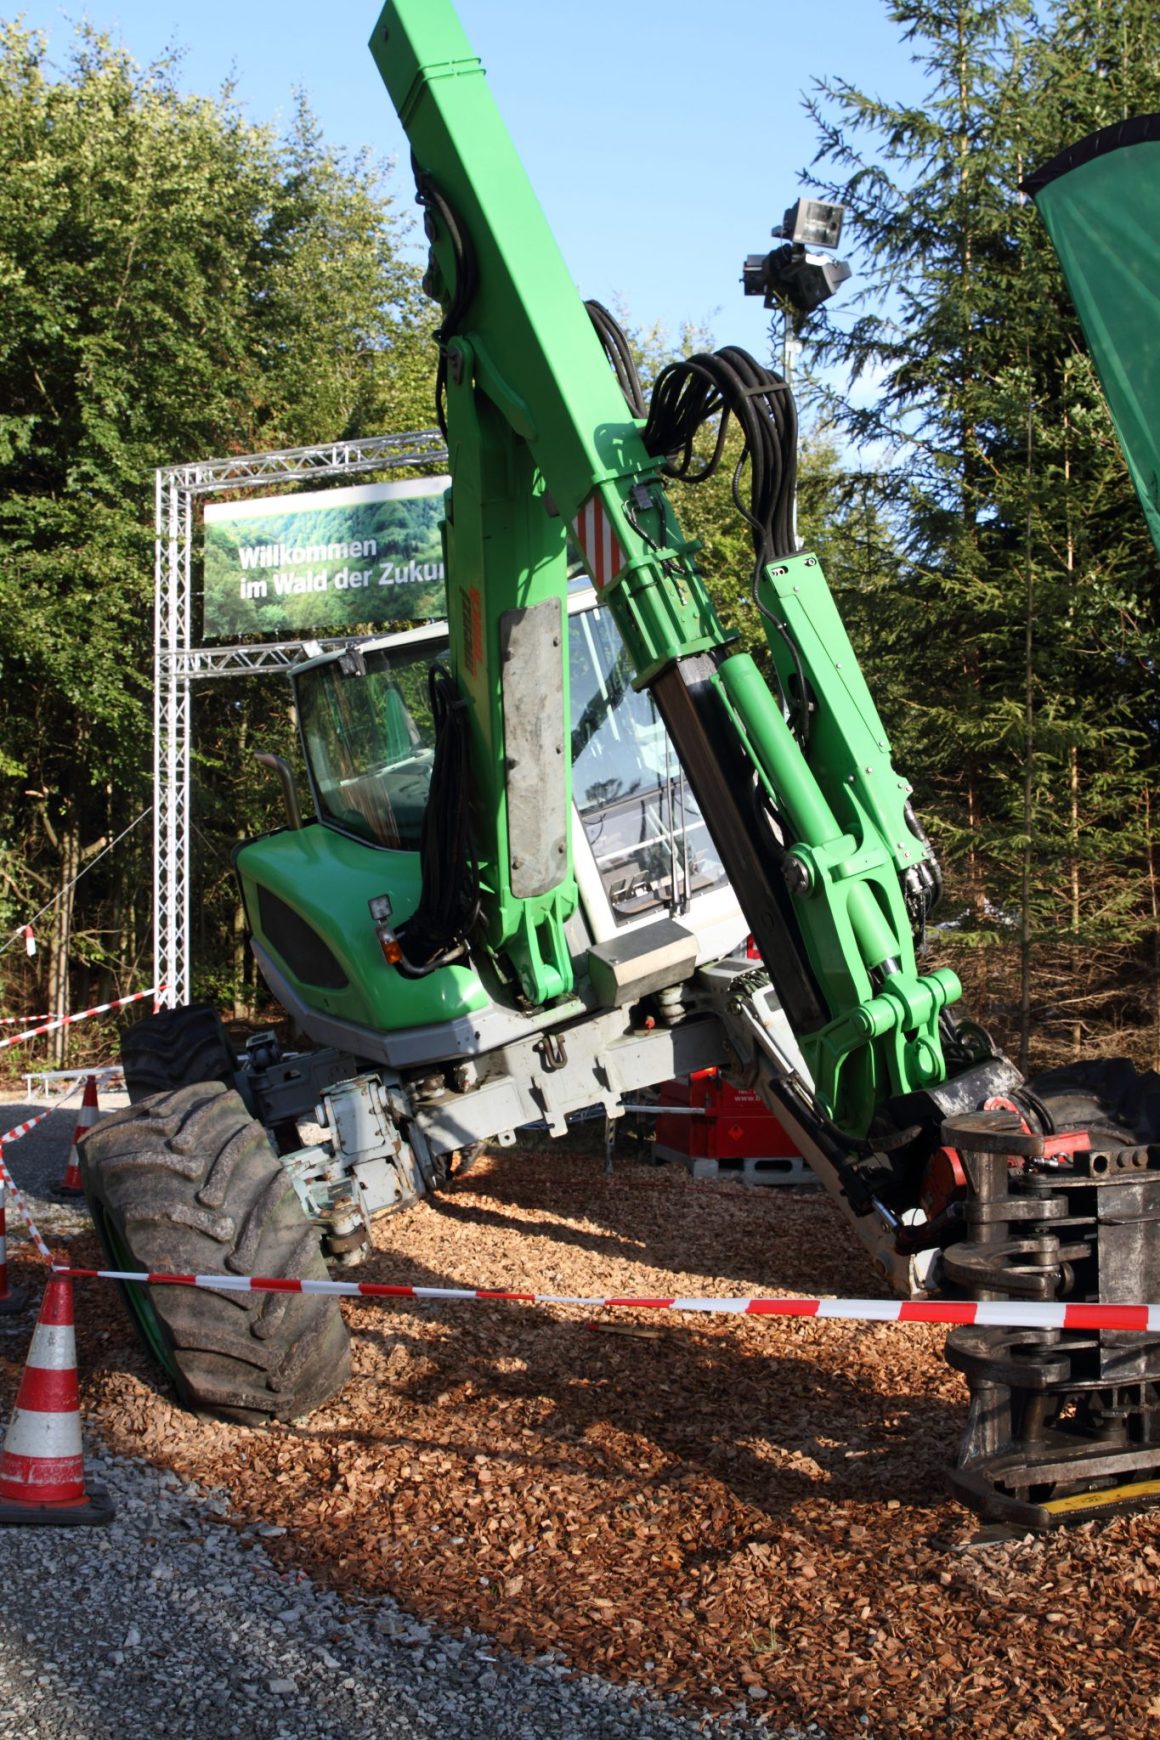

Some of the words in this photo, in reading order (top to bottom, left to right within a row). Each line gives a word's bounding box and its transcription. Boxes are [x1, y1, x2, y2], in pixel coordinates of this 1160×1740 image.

[239, 538, 377, 569] Willkommen
[240, 577, 268, 599] im
[272, 568, 328, 596] Wald
[334, 566, 373, 589] der
